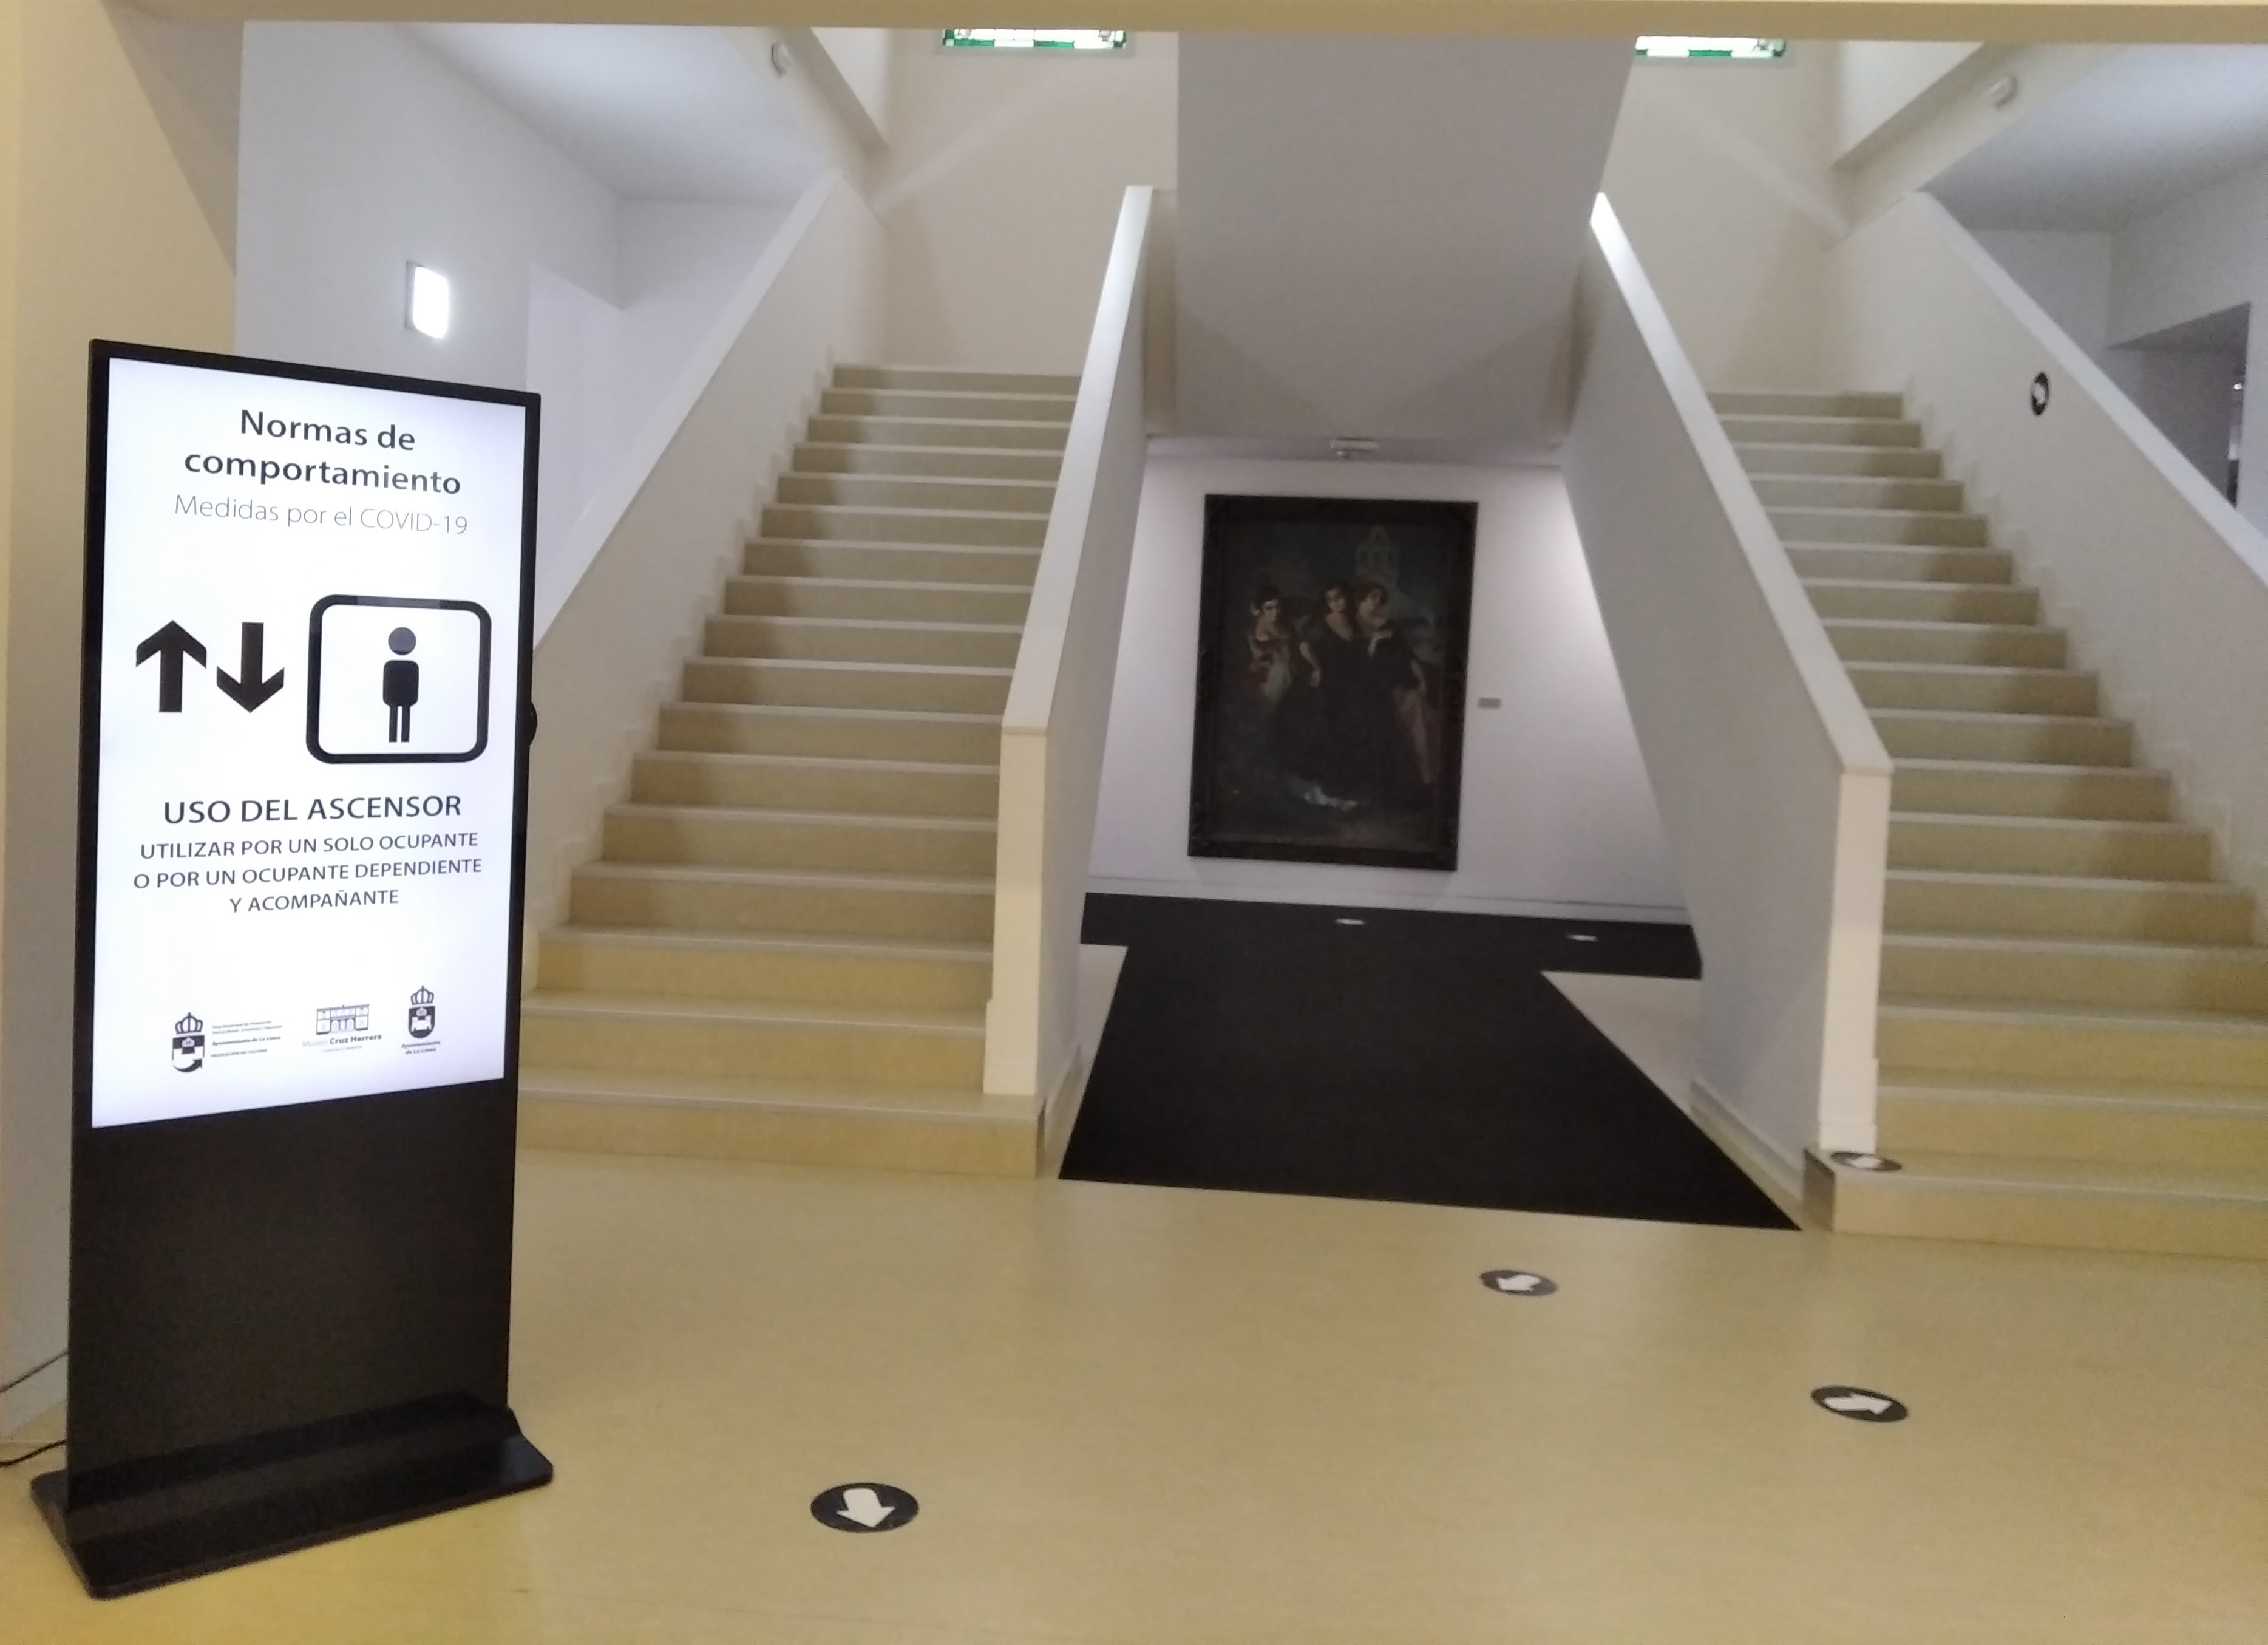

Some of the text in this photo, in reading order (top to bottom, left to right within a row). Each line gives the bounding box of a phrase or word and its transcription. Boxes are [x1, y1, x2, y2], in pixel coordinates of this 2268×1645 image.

[241, 409, 415, 451] Normas de
[184, 452, 461, 494] comportamiento
[175, 494, 467, 534] Medidas por el COVID-19
[165, 795, 461, 824] USO DEL ASCENSOR
[141, 832, 478, 859] UTILIZAR POR UN SOLO OCUPANTE
[134, 859, 482, 888] O POR UN OCUPANTE DEPENDIENTE
[230, 890, 398, 913] Y ACOMPAÑANTE
[350, 1034, 382, 1042] Herrera
